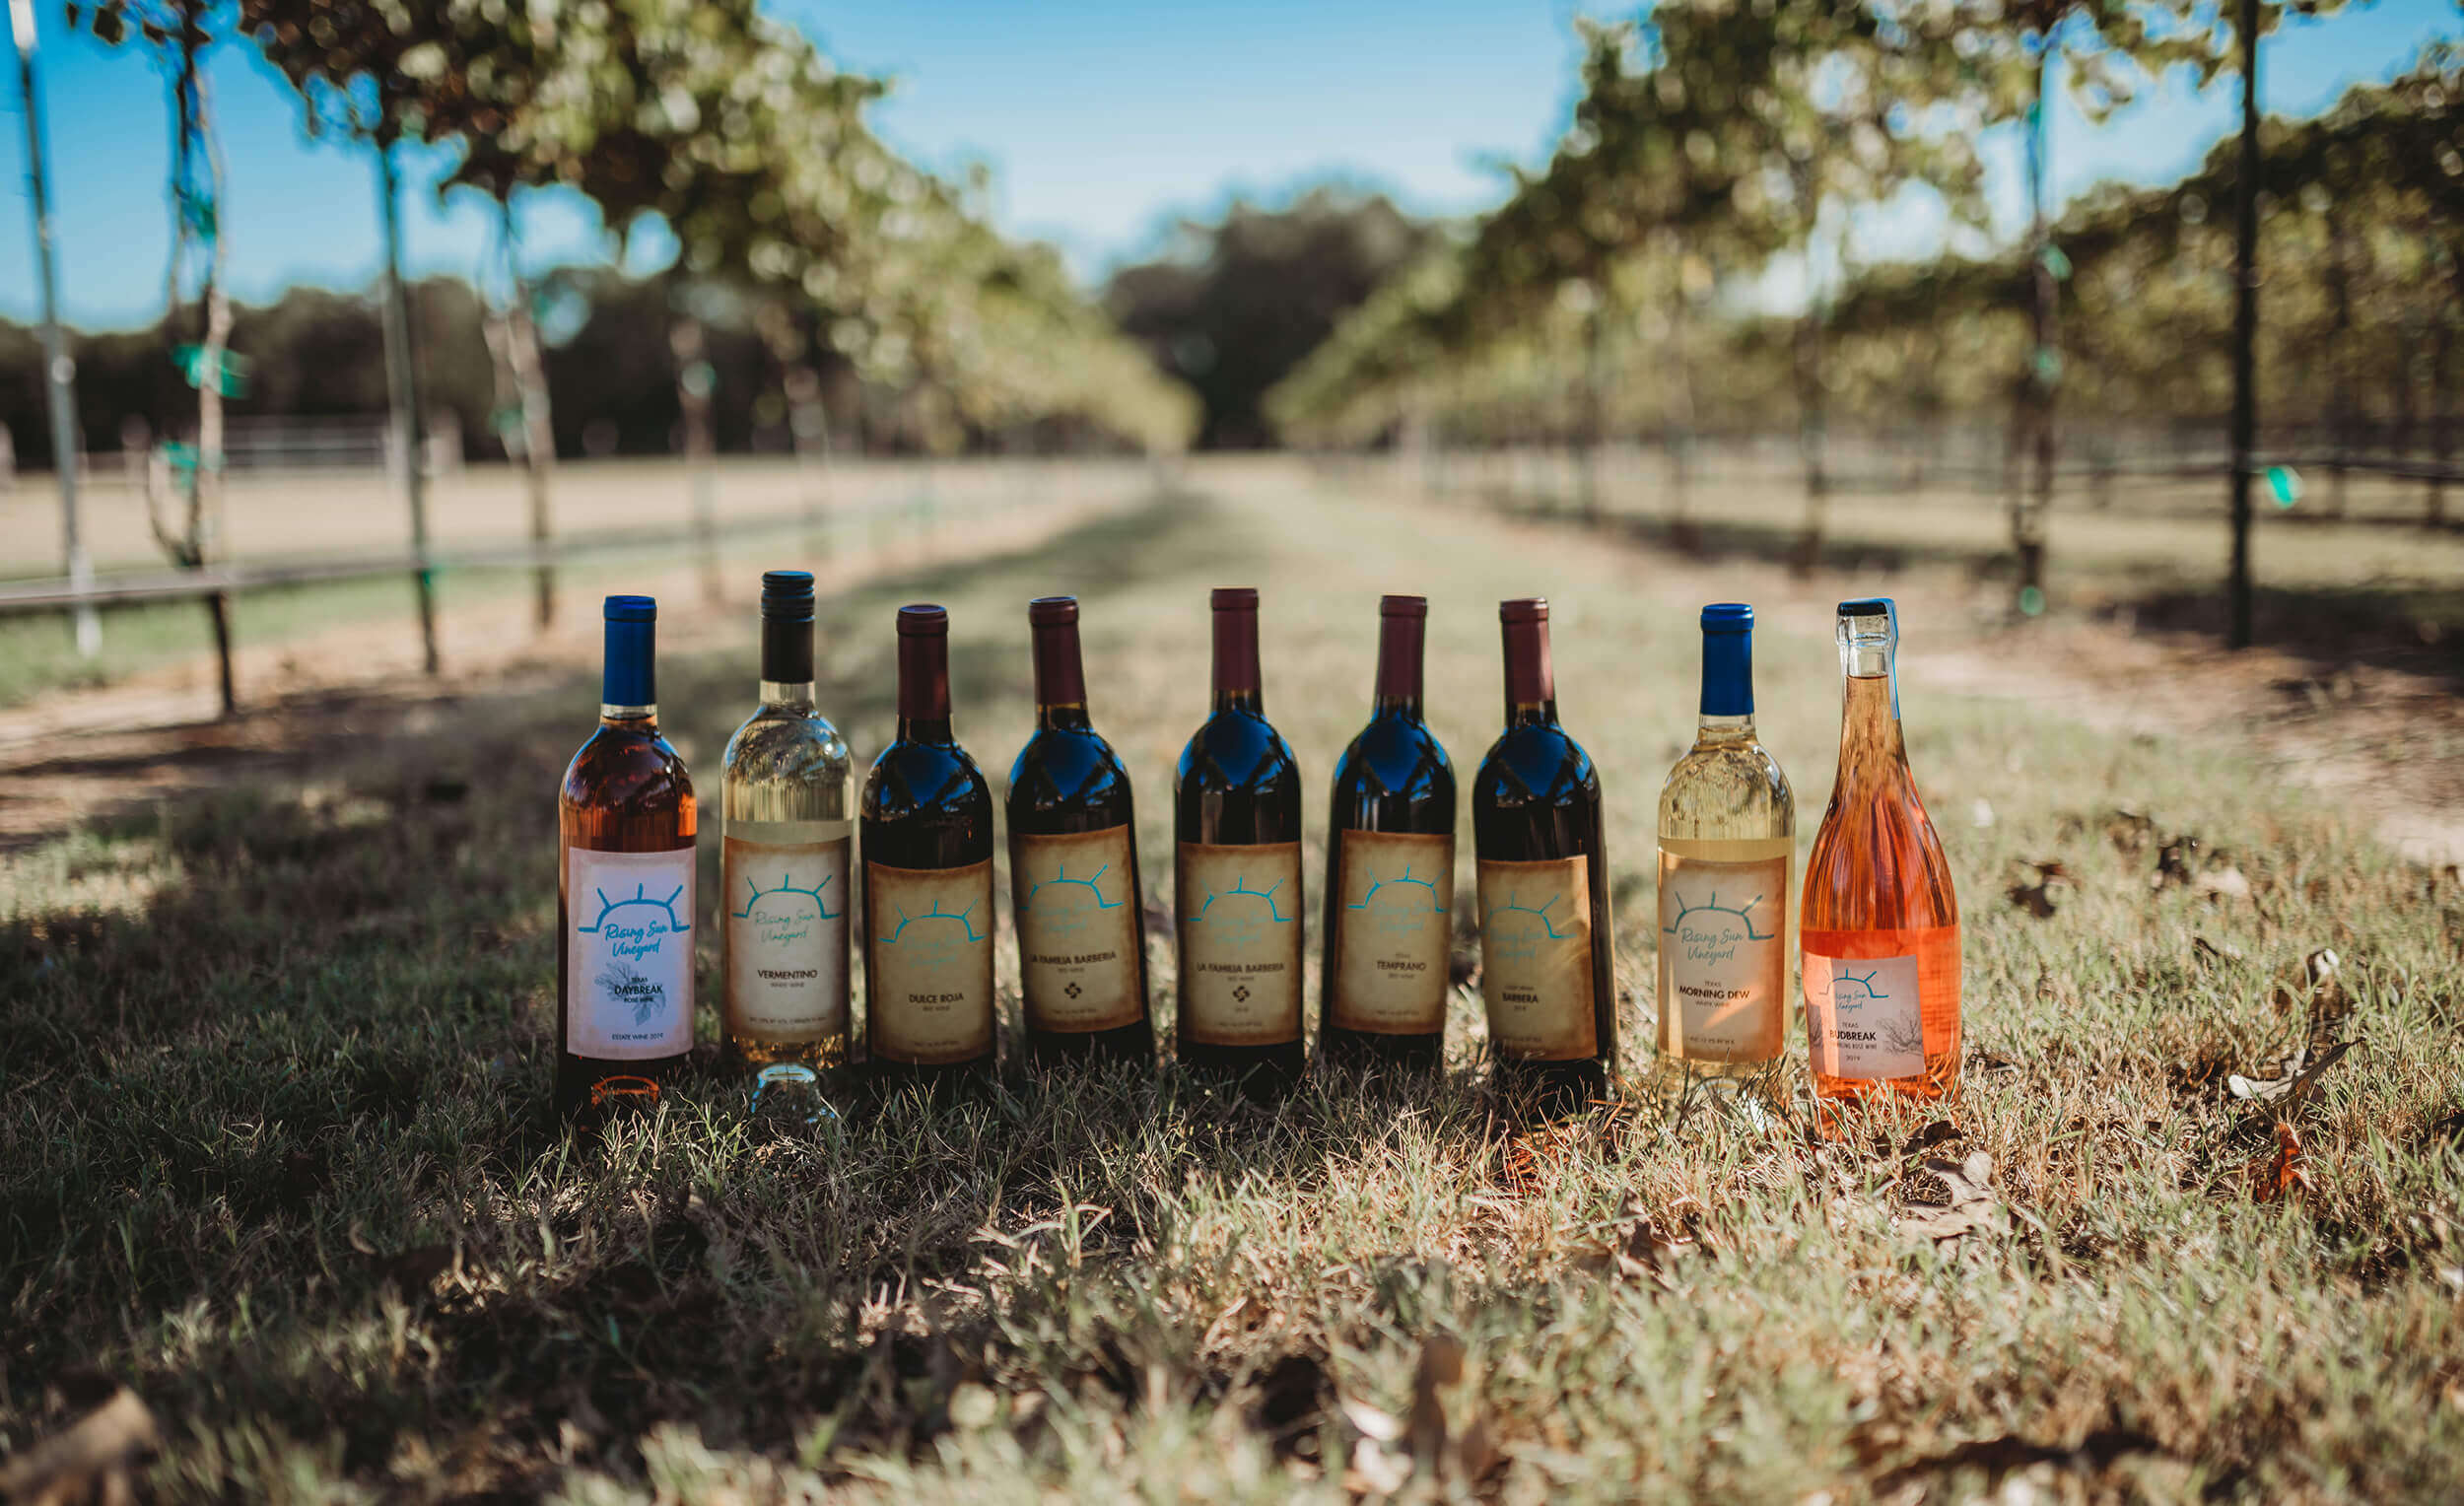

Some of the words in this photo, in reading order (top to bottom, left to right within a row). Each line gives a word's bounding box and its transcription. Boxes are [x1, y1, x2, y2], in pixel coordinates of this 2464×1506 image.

[755, 911, 790, 931] Rising
[794, 909, 815, 925] Sun
[604, 923, 645, 942] Rising
[647, 921, 668, 938] Sun
[761, 926, 808, 947] Vineyard
[1680, 926, 1717, 948] Rising
[1720, 927, 1744, 945] Sun
[612, 938, 661, 961] Vineyard
[1686, 945, 1735, 966] Vineyard
[1376, 960, 1426, 972] TEMPRANO
[757, 969, 818, 980] VERMENTINO
[614, 985, 663, 995] DAYBREAK
[1678, 986, 1725, 999] MORNING
[1728, 989, 1750, 999] DEW
[909, 993, 938, 1003] DULCE
[939, 992, 964, 1003] ROJA
[1502, 993, 1539, 1004] BARBERA
[1829, 1029, 1877, 1041] BUDBREAK
